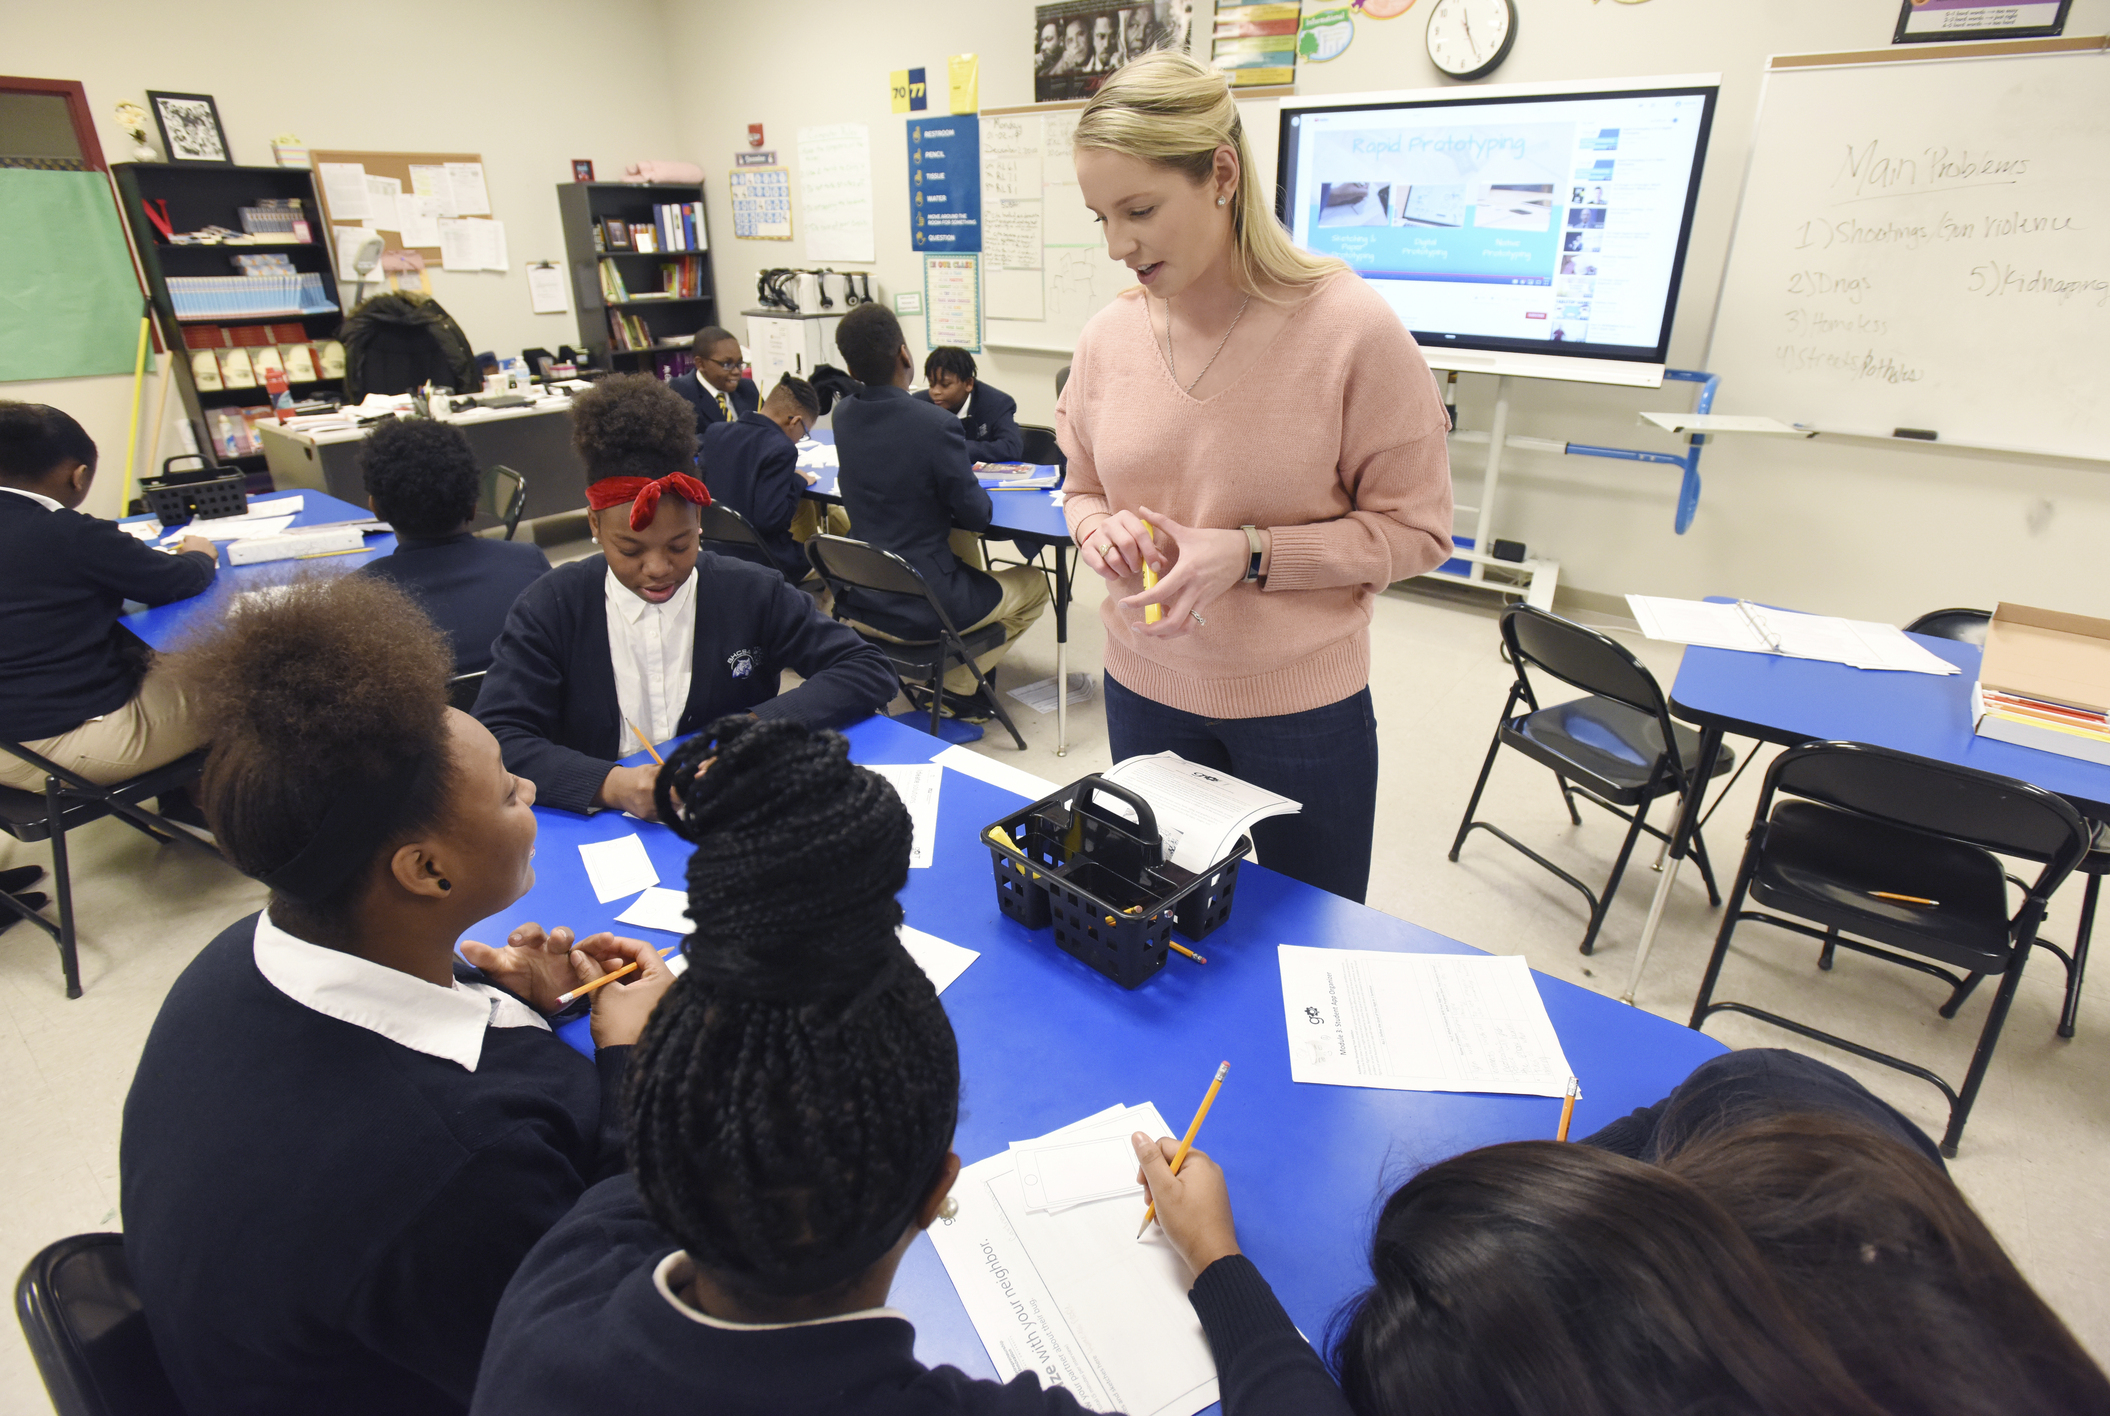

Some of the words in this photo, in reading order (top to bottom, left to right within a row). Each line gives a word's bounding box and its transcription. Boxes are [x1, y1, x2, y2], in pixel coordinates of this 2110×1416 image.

[1305, 11, 1345, 26] Informational
[892, 87, 906, 98] 70
[924, 128, 955, 138] RESTROOM
[924, 150, 946, 159] PENCIL
[1352, 135, 1402, 160] Rapid
[1408, 134, 1526, 160] Prototyping
[1830, 139, 1916, 196] Main
[1924, 146, 2031, 185] Problems
[926, 172, 946, 180] TISSUE
[926, 195, 948, 203] WATER
[928, 234, 956, 242] QUESTION
[1402, 247, 1448, 259] Prototyping
[1482, 248, 1532, 262] Prototyping
[1327, 972, 1335, 994] Organizer
[1333, 1007, 1341, 1027] Student
[1338, 1035, 1346, 1055] Module
[980, 1239, 1016, 1297] neighbor.
[1030, 1298, 1040, 1314] bug.
[1010, 1301, 1036, 1330] your
[1037, 1315, 1049, 1331] their
[1027, 1331, 1049, 1363] with
[1046, 1331, 1061, 1352] about
[1059, 1354, 1078, 1381] partner
[1093, 1355, 1102, 1369] here
[1100, 1368, 1116, 1392] sketches
[1074, 1383, 1089, 1400] your
[1113, 1393, 1123, 1404] and
